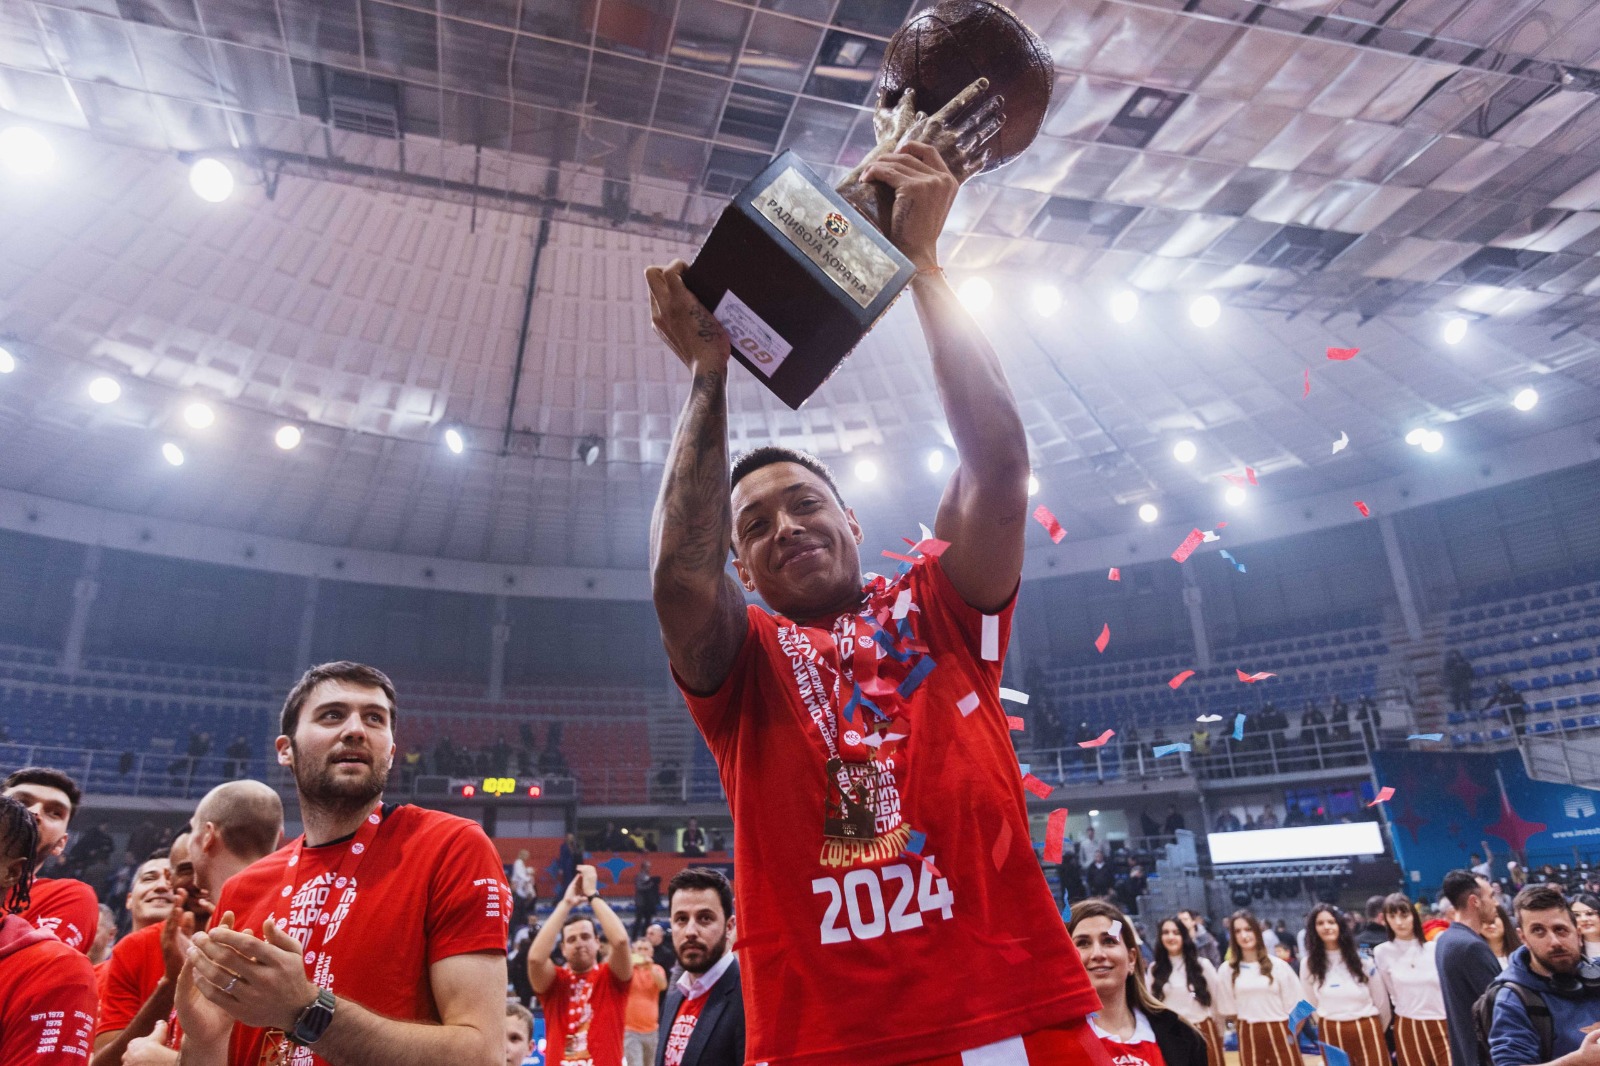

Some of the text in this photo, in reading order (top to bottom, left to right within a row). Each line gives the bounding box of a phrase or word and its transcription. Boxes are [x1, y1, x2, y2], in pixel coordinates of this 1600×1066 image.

[813, 225, 840, 250] КУП
[767, 198, 869, 295] РАДИВОЈА КОРАЋА
[812, 855, 955, 945] 2024
[30, 1013, 47, 1022] 1971
[42, 1028, 61, 1036] 2004
[36, 1045, 55, 1054] 2013
